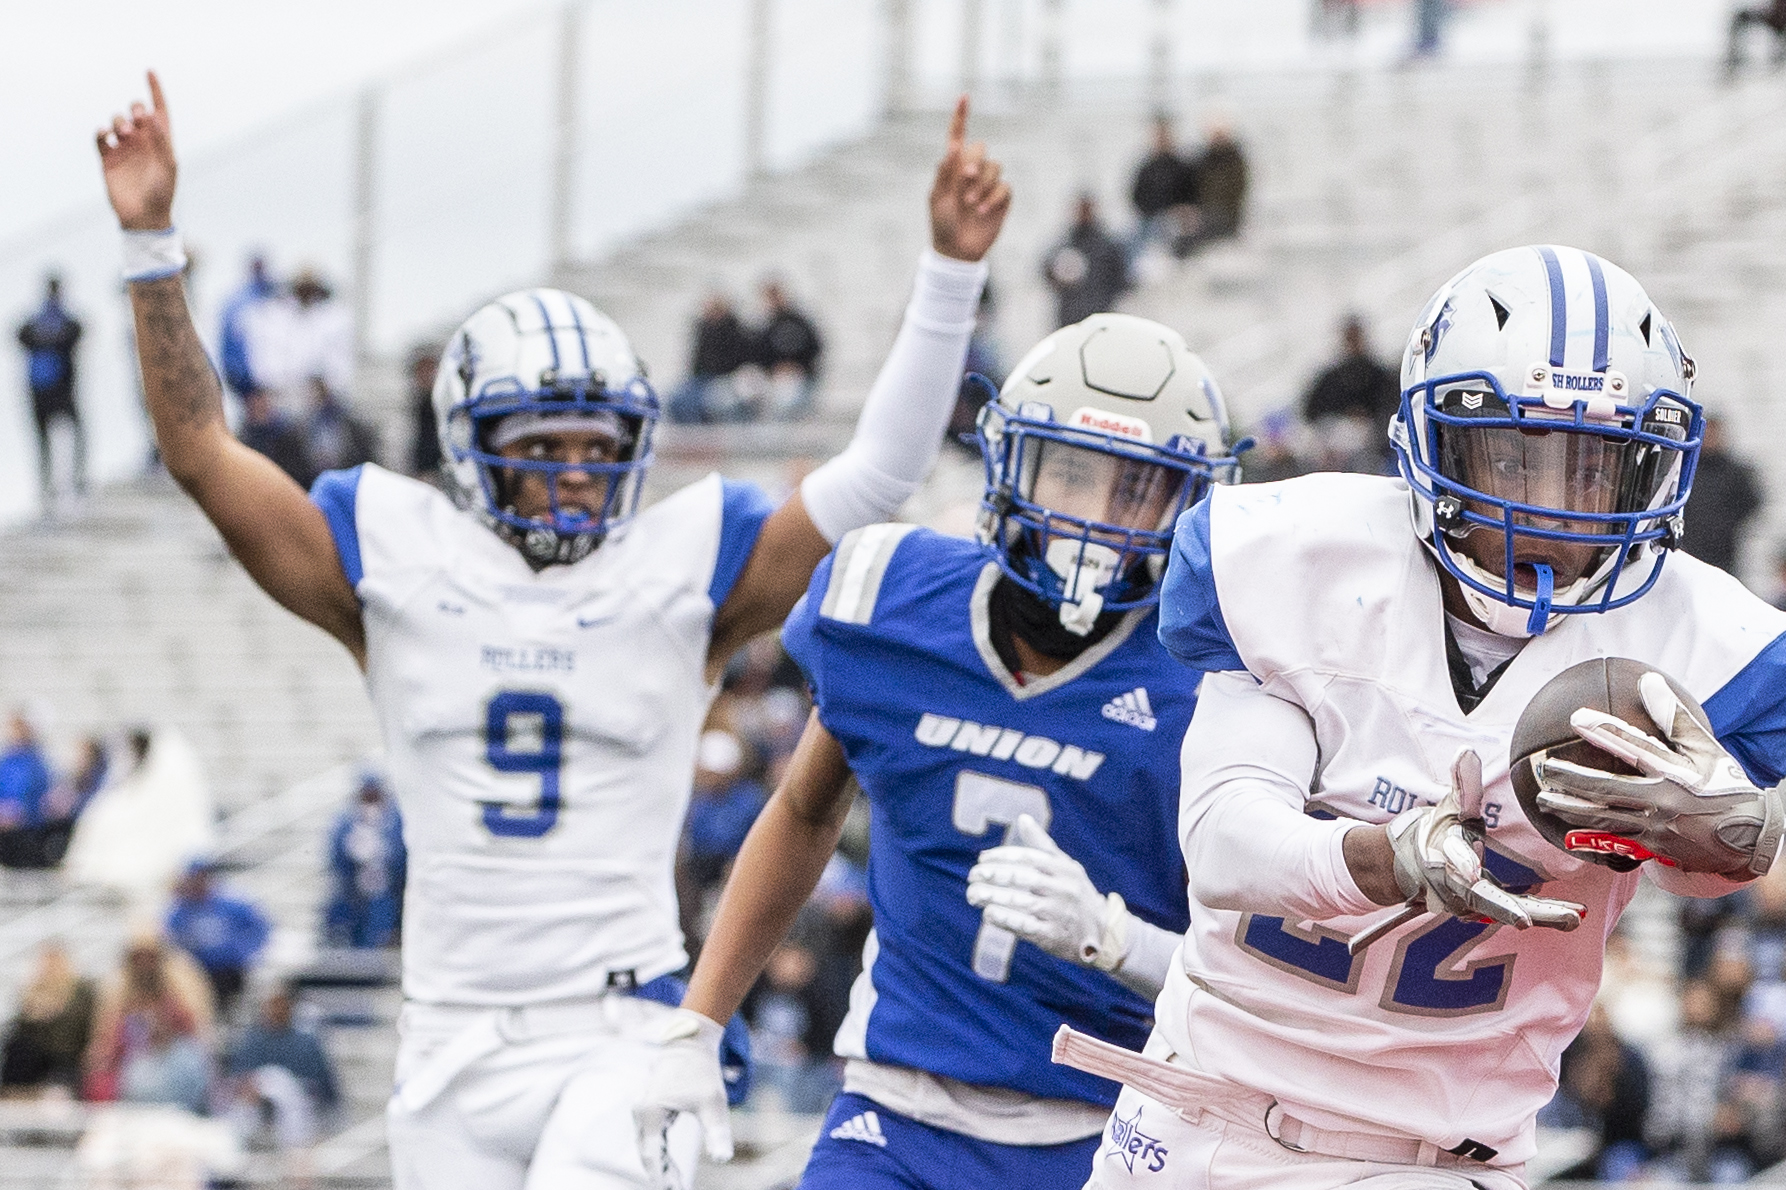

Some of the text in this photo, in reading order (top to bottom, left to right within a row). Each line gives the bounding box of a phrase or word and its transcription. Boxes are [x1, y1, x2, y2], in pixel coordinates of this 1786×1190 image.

[1566, 374, 1604, 392] ROLLERS
[478, 687, 568, 840] 9
[914, 712, 1106, 781] UNION
[952, 769, 1051, 984] 7
